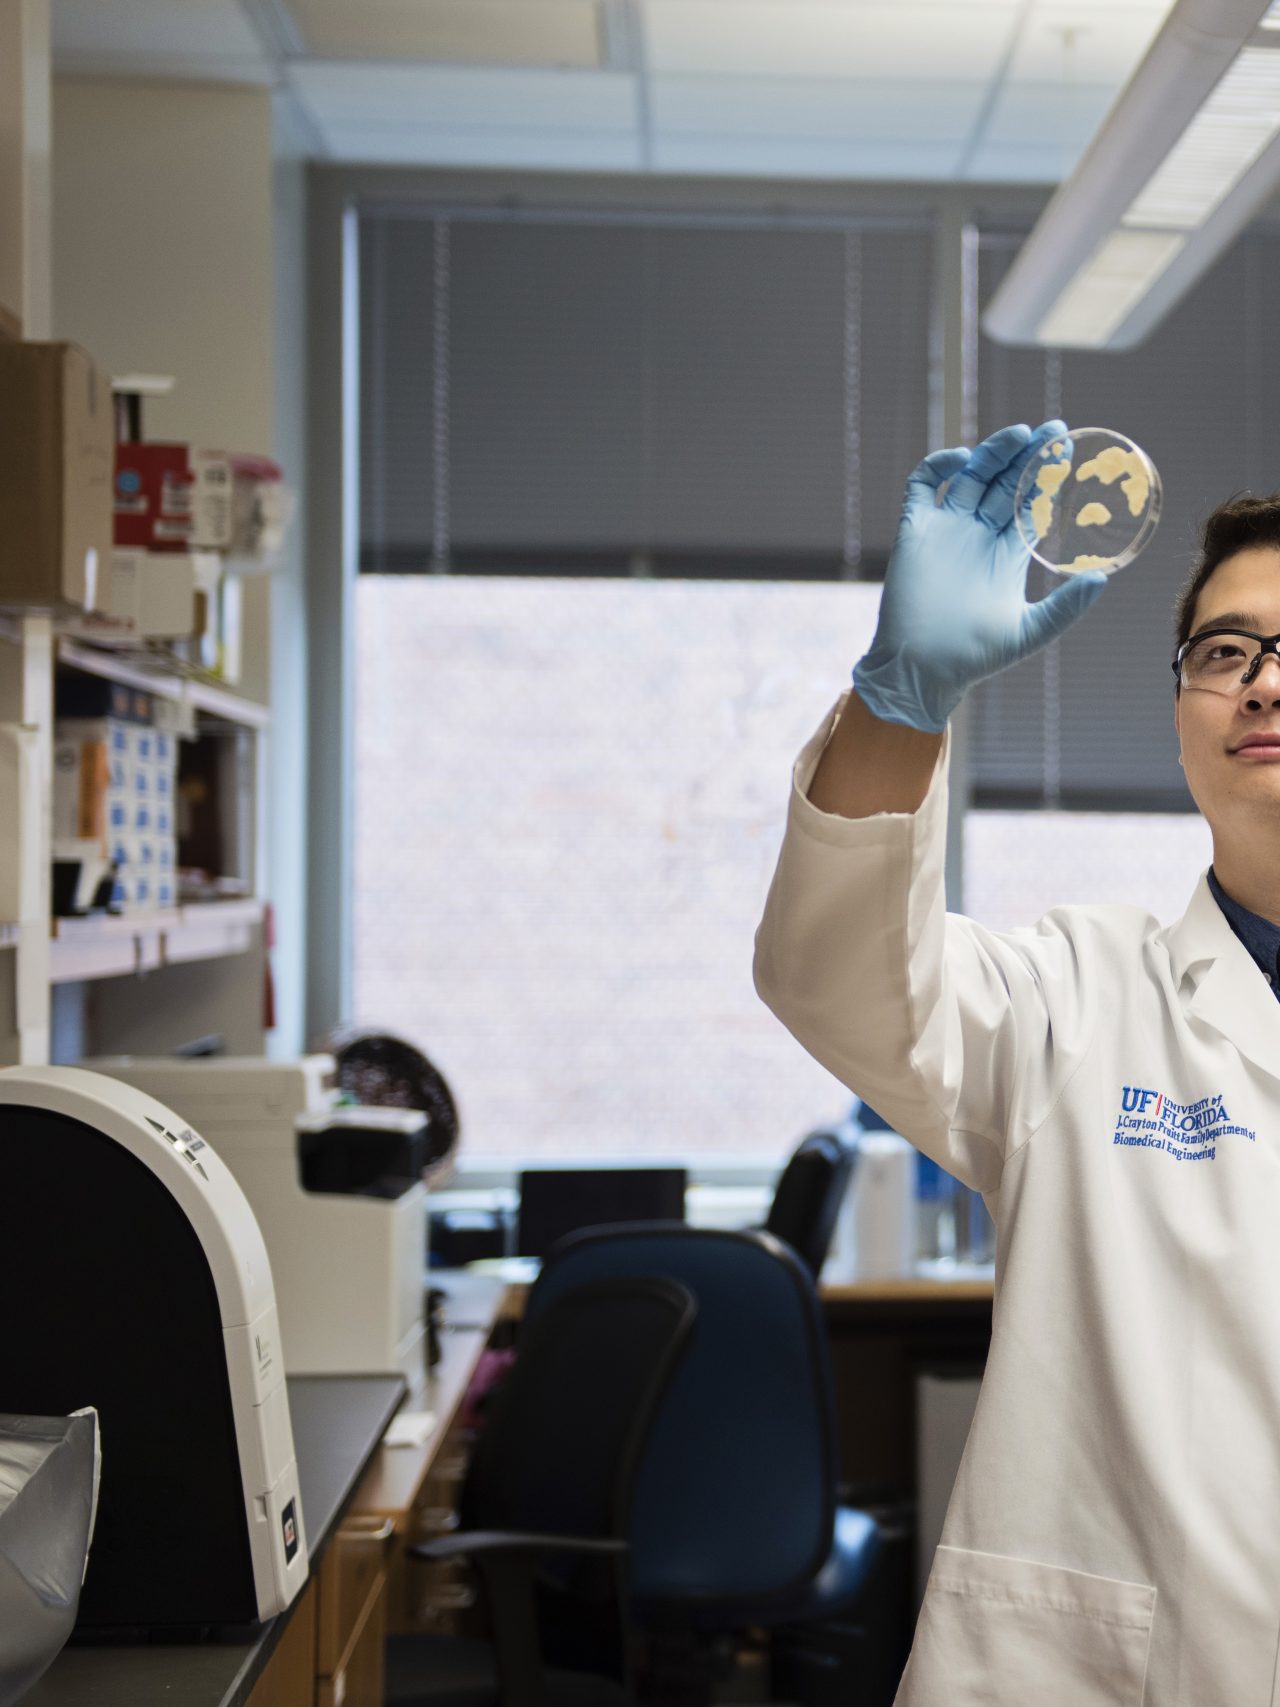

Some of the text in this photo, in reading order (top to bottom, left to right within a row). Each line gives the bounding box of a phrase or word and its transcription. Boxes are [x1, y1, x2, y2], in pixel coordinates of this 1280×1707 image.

[1121, 1085, 1159, 1113] UF
[1163, 1094, 1223, 1116] UNIVERSITY of
[1160, 1105, 1231, 1132] FLORIDA
[1113, 1131, 1217, 1161] Biomedical Engineering
[1157, 1121, 1181, 1142] Pruitt
[1180, 1131, 1206, 1147] Family
[1204, 1124, 1248, 1142] Department
[1248, 1131, 1256, 1142] of
